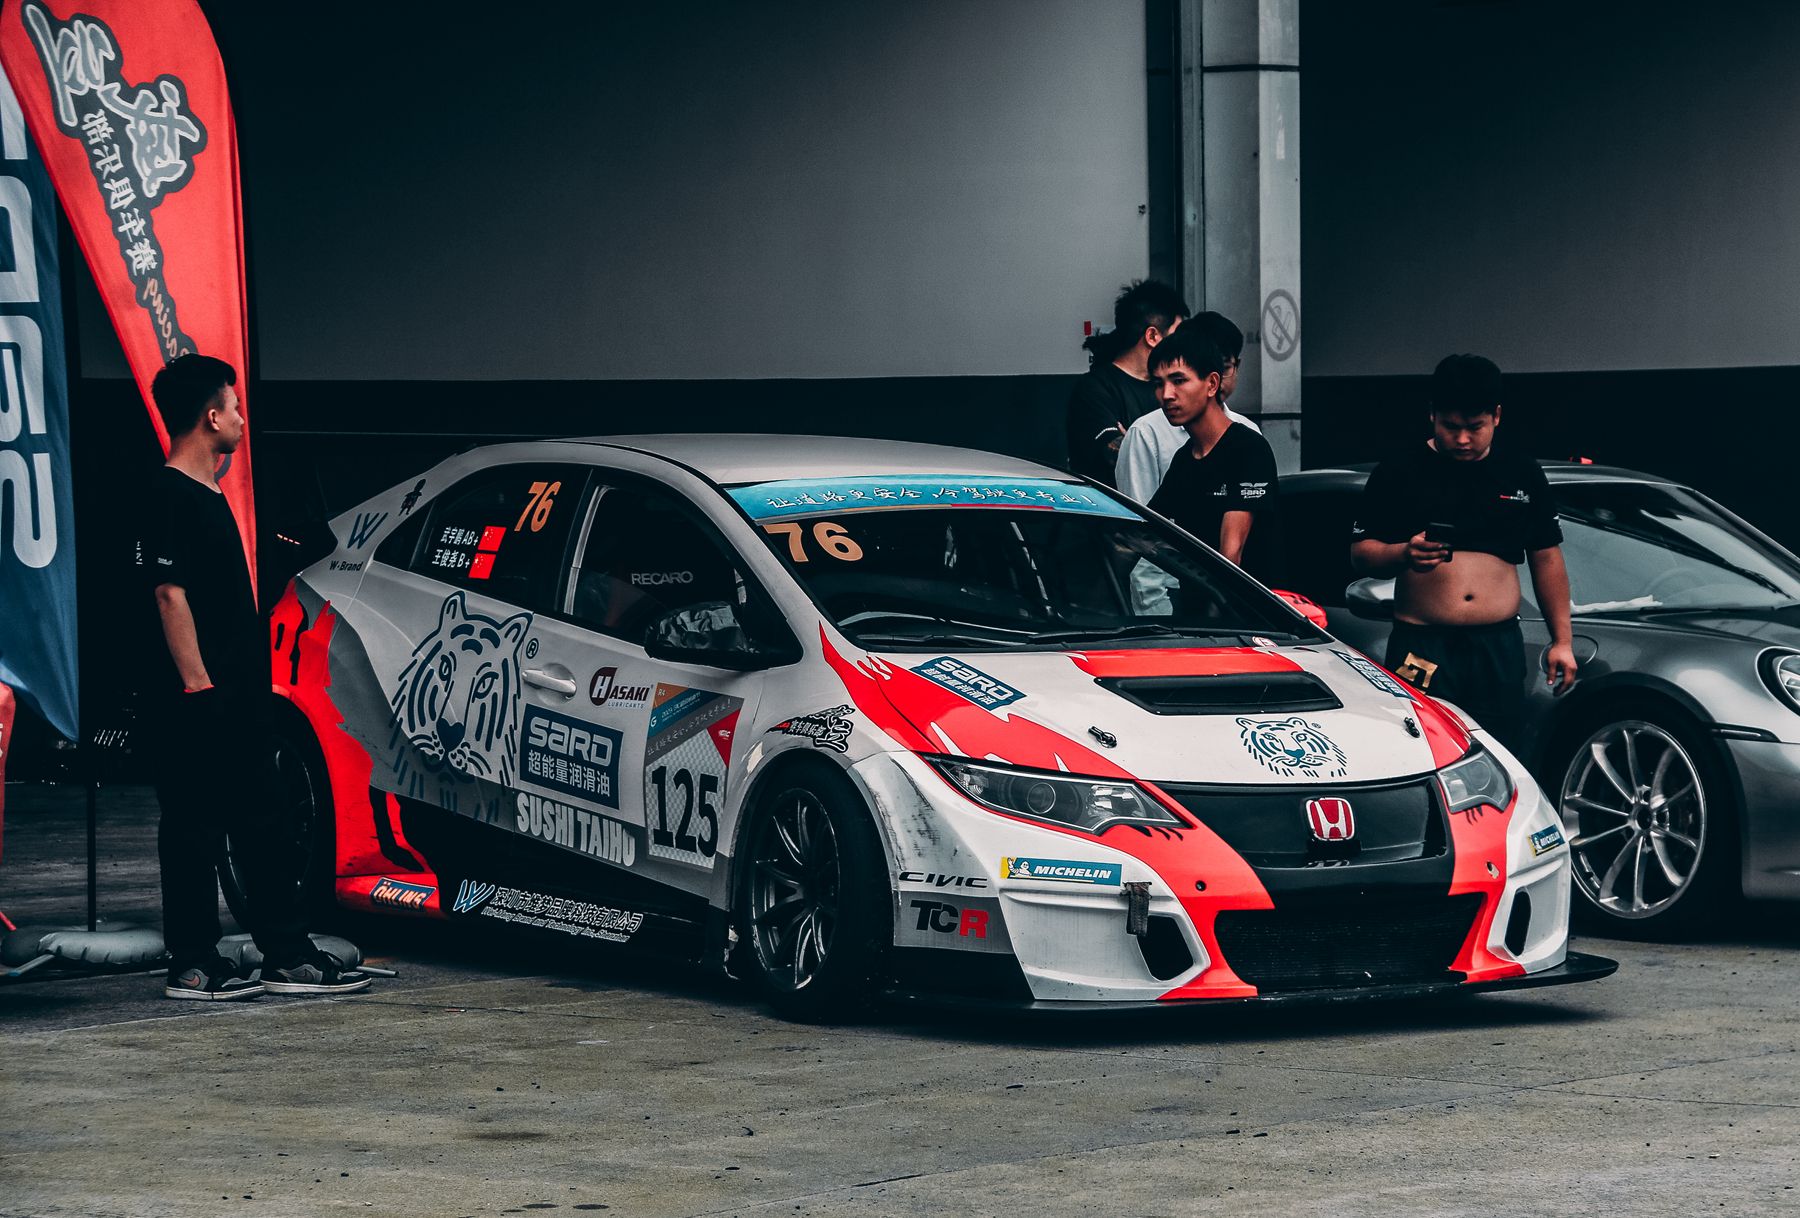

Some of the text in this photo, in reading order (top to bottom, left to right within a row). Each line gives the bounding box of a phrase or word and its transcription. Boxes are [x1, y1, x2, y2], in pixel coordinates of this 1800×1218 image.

[514, 481, 562, 532] 76
[763, 521, 863, 562] 76
[631, 571, 693, 585] RECARO
[591, 670, 651, 703] HASAKI
[528, 749, 610, 798] 超能量润滑油
[517, 792, 575, 849] SUSHI
[651, 766, 719, 858] 125
[899, 871, 988, 888] CIVIC
[1033, 865, 1112, 879] MICHELIN
[910, 900, 989, 938] TCR
